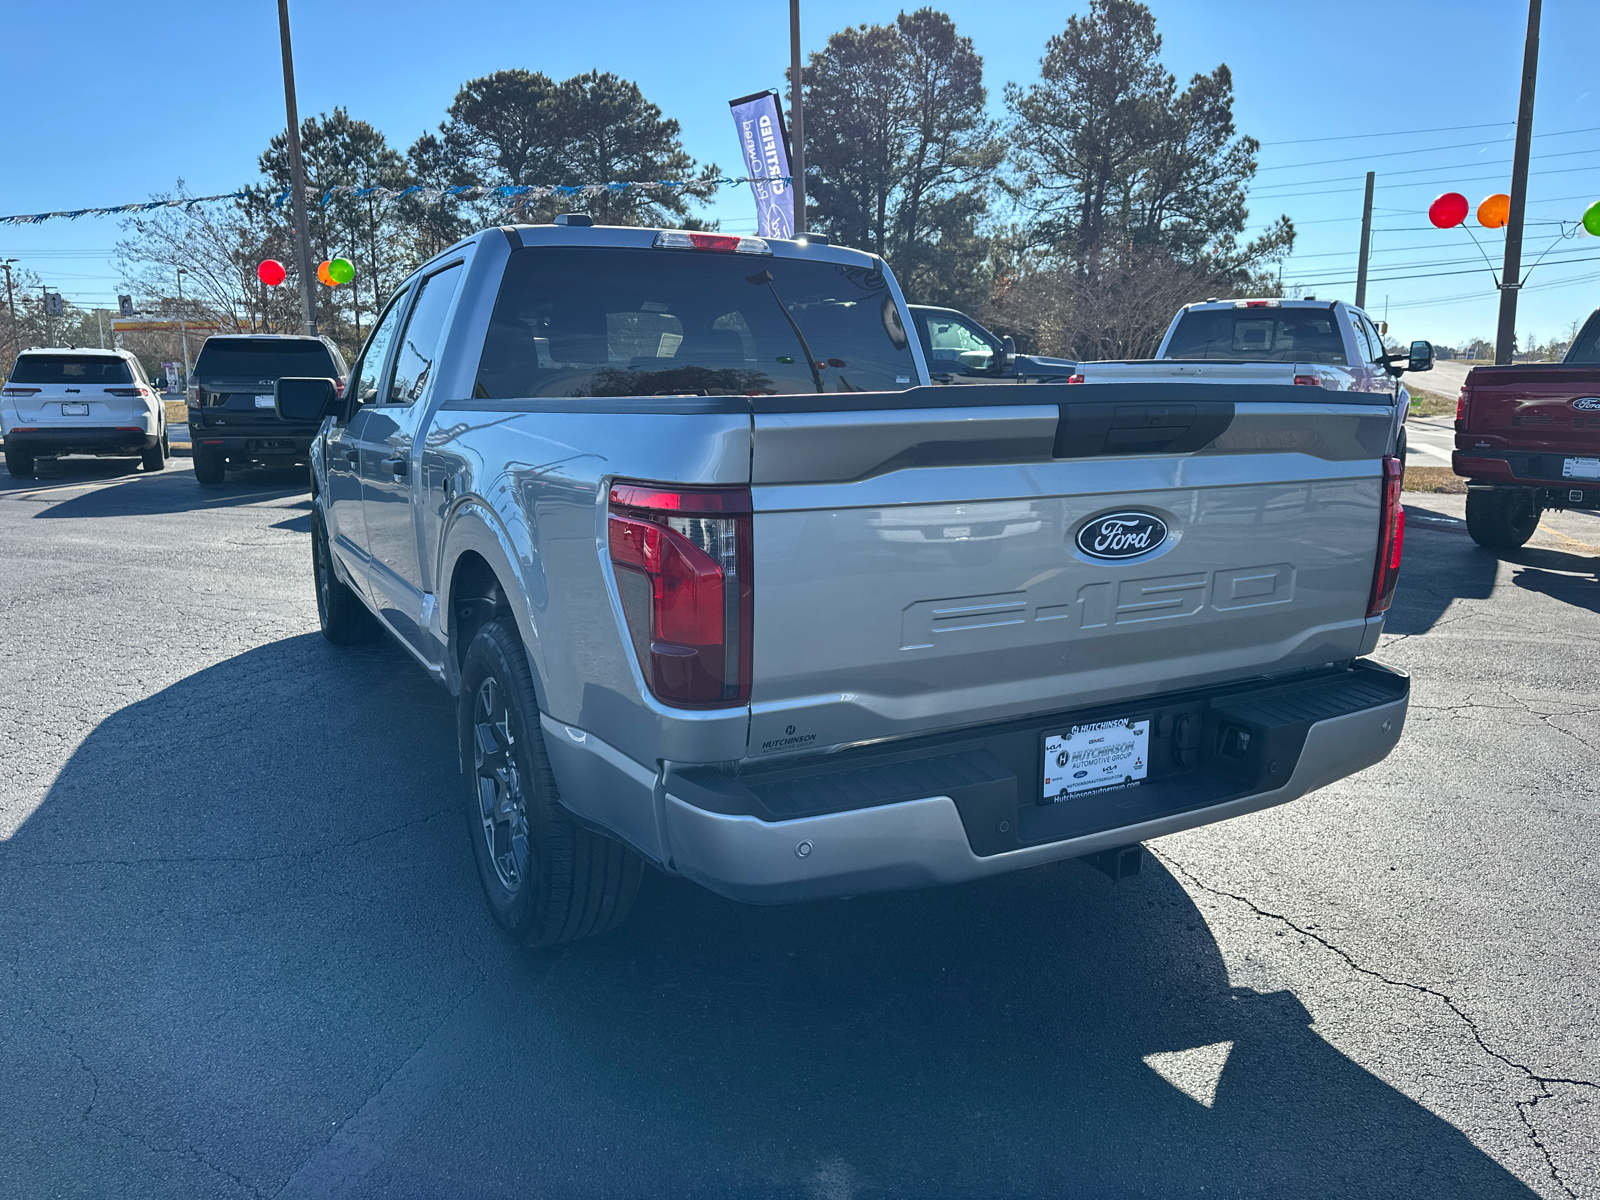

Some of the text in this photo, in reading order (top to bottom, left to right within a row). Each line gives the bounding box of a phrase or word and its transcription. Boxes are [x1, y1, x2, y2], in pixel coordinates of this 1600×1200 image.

[1094, 519, 1153, 551] Ford
[900, 562, 1297, 651] F-150
[1081, 718, 1129, 733] HUTCHINSON
[762, 734, 817, 749] HUTCHINSON
[762, 745, 795, 753] AUTOMOTIVE
[1071, 741, 1135, 762] HUTCHINSON
[1072, 752, 1132, 769] AUTOMOTIVE GROUP
